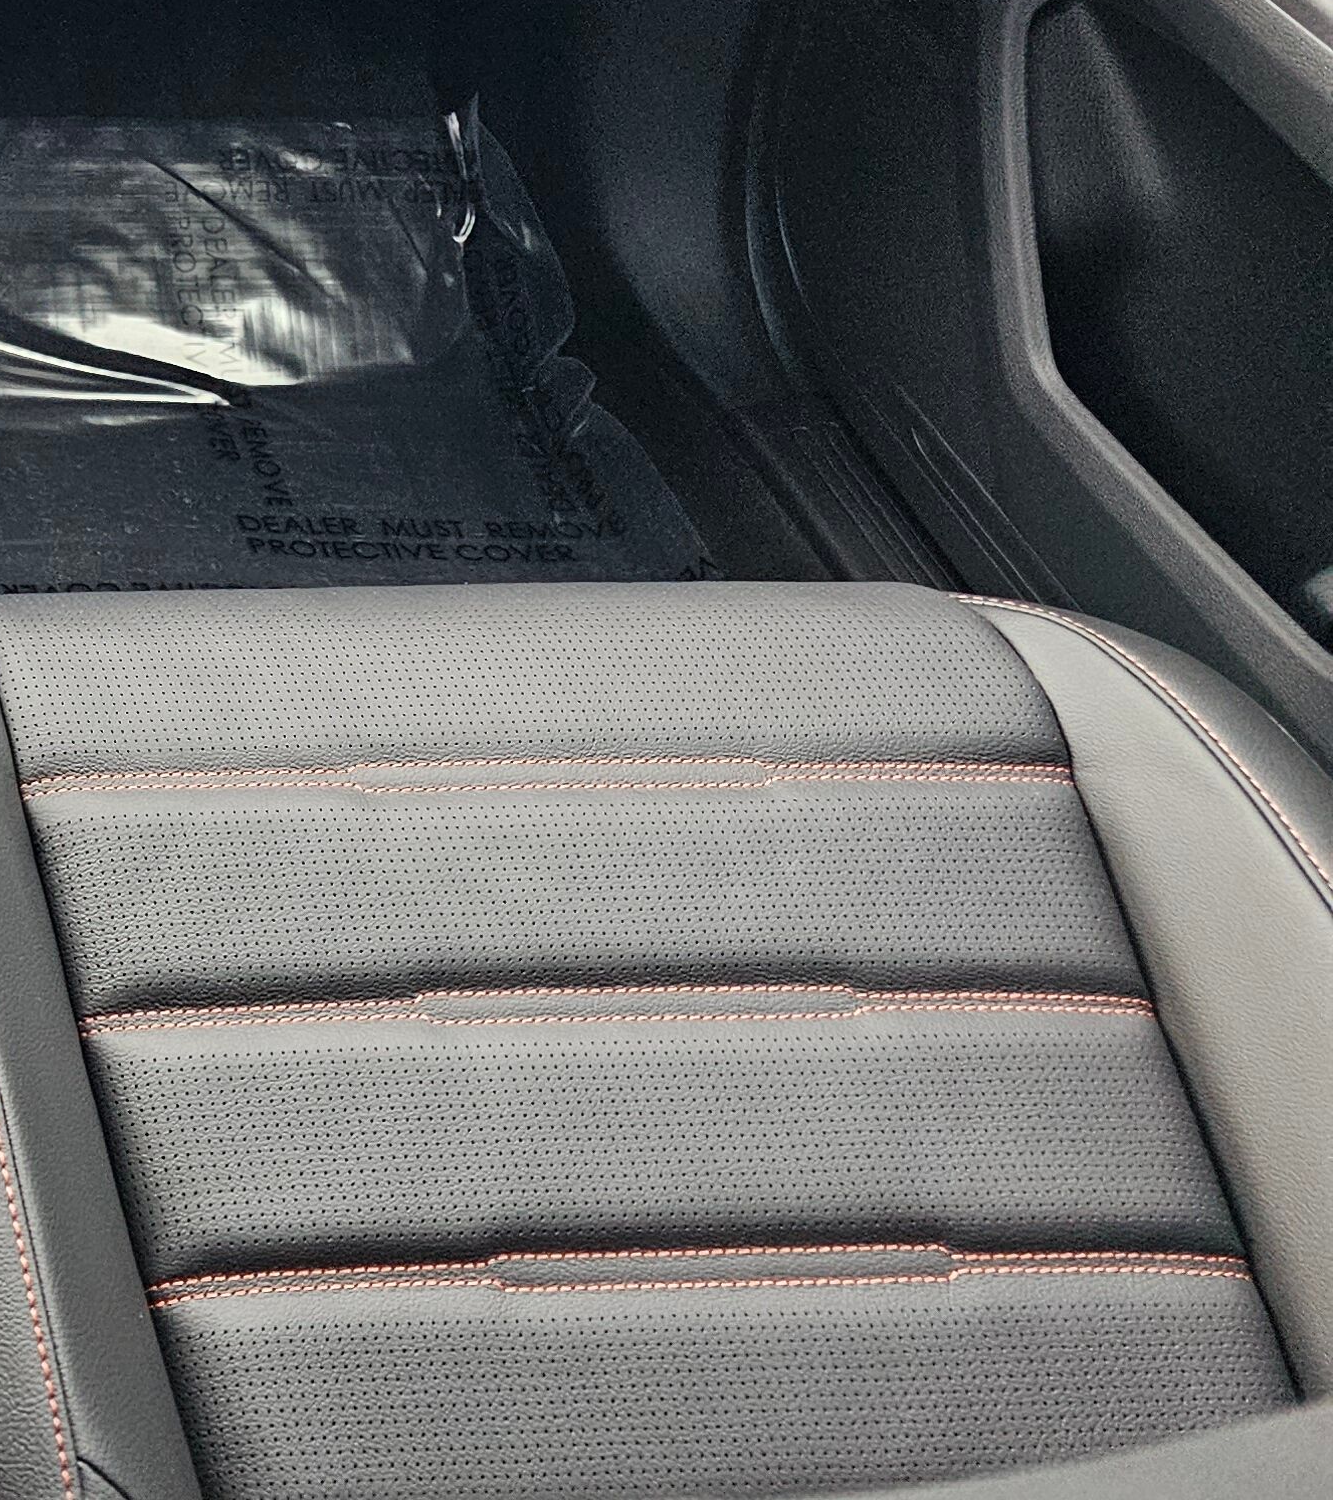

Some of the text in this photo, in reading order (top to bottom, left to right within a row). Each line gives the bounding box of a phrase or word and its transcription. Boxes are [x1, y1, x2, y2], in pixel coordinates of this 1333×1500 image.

[236, 513, 361, 537] DEALER
[379, 517, 466, 541] MUST
[245, 536, 577, 564] PROTECTIVE COVER
